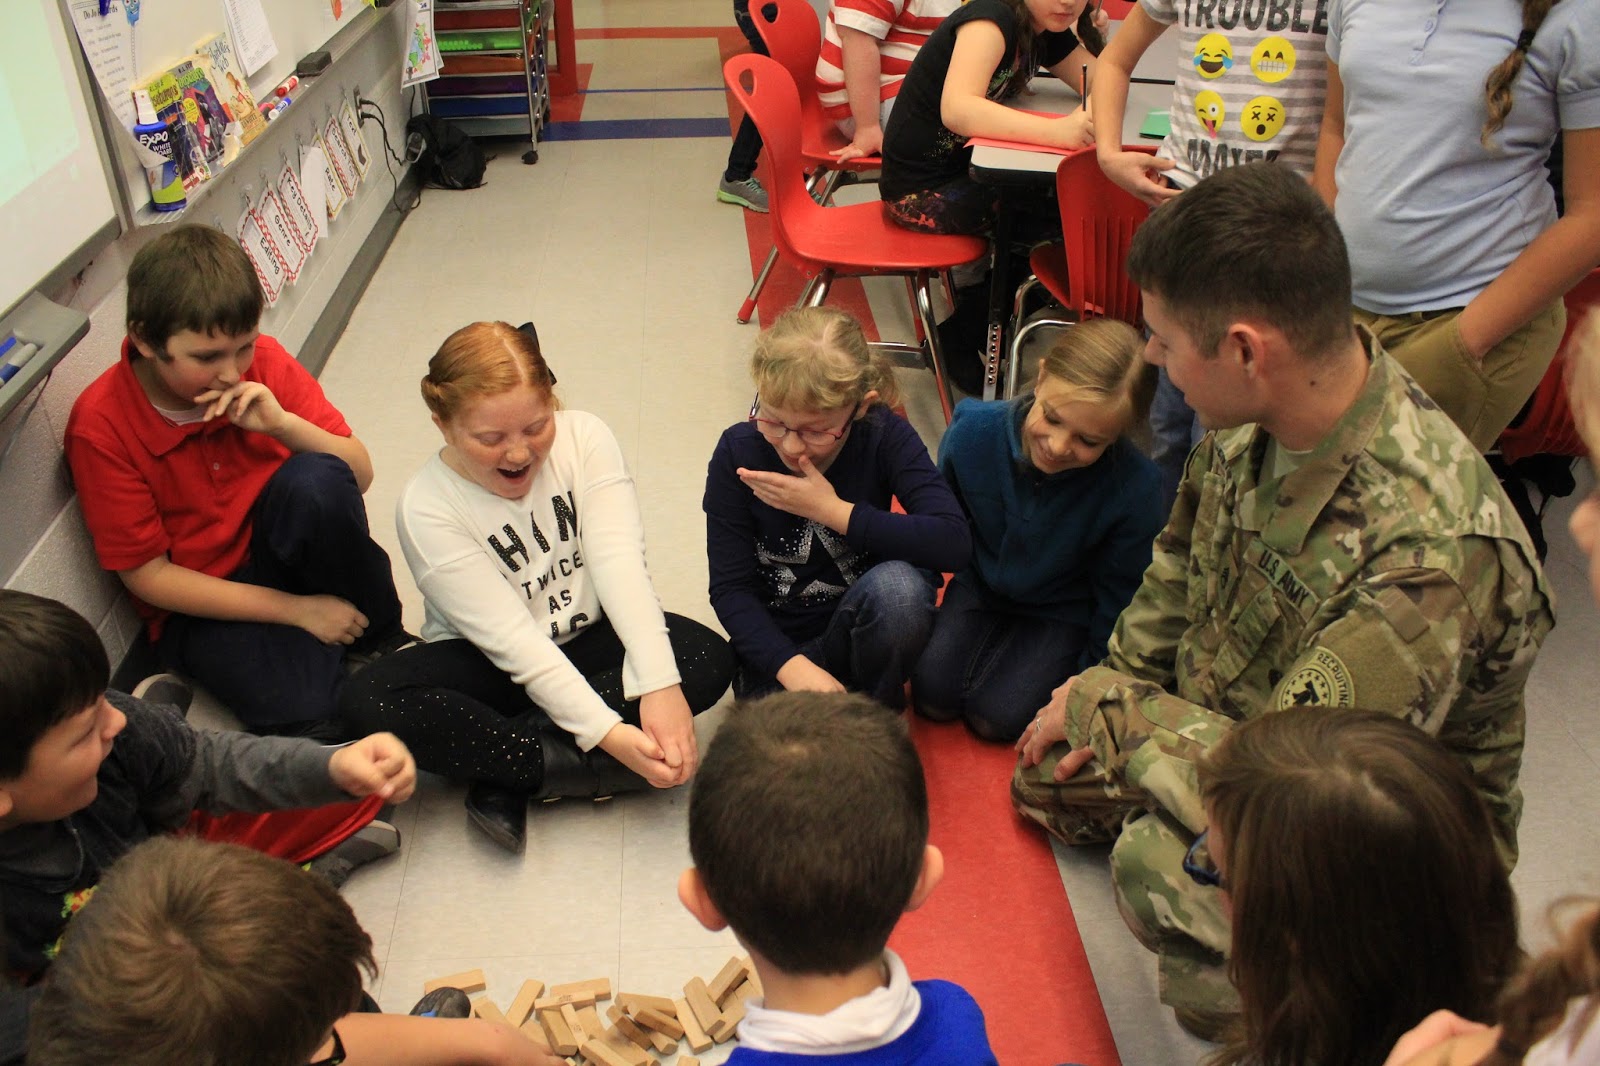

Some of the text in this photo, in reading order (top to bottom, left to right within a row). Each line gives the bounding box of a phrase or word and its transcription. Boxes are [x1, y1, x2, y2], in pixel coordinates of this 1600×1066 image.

[140, 131, 168, 149] EXPO
[287, 176, 296, 200] Key
[296, 198, 313, 230] Details
[274, 214, 291, 247] Genre
[260, 236, 280, 275] Editing
[487, 490, 582, 573] HIN
[521, 551, 584, 600] TWICE
[548, 589, 572, 615] AS
[1317, 652, 1349, 708] RECRUITING
